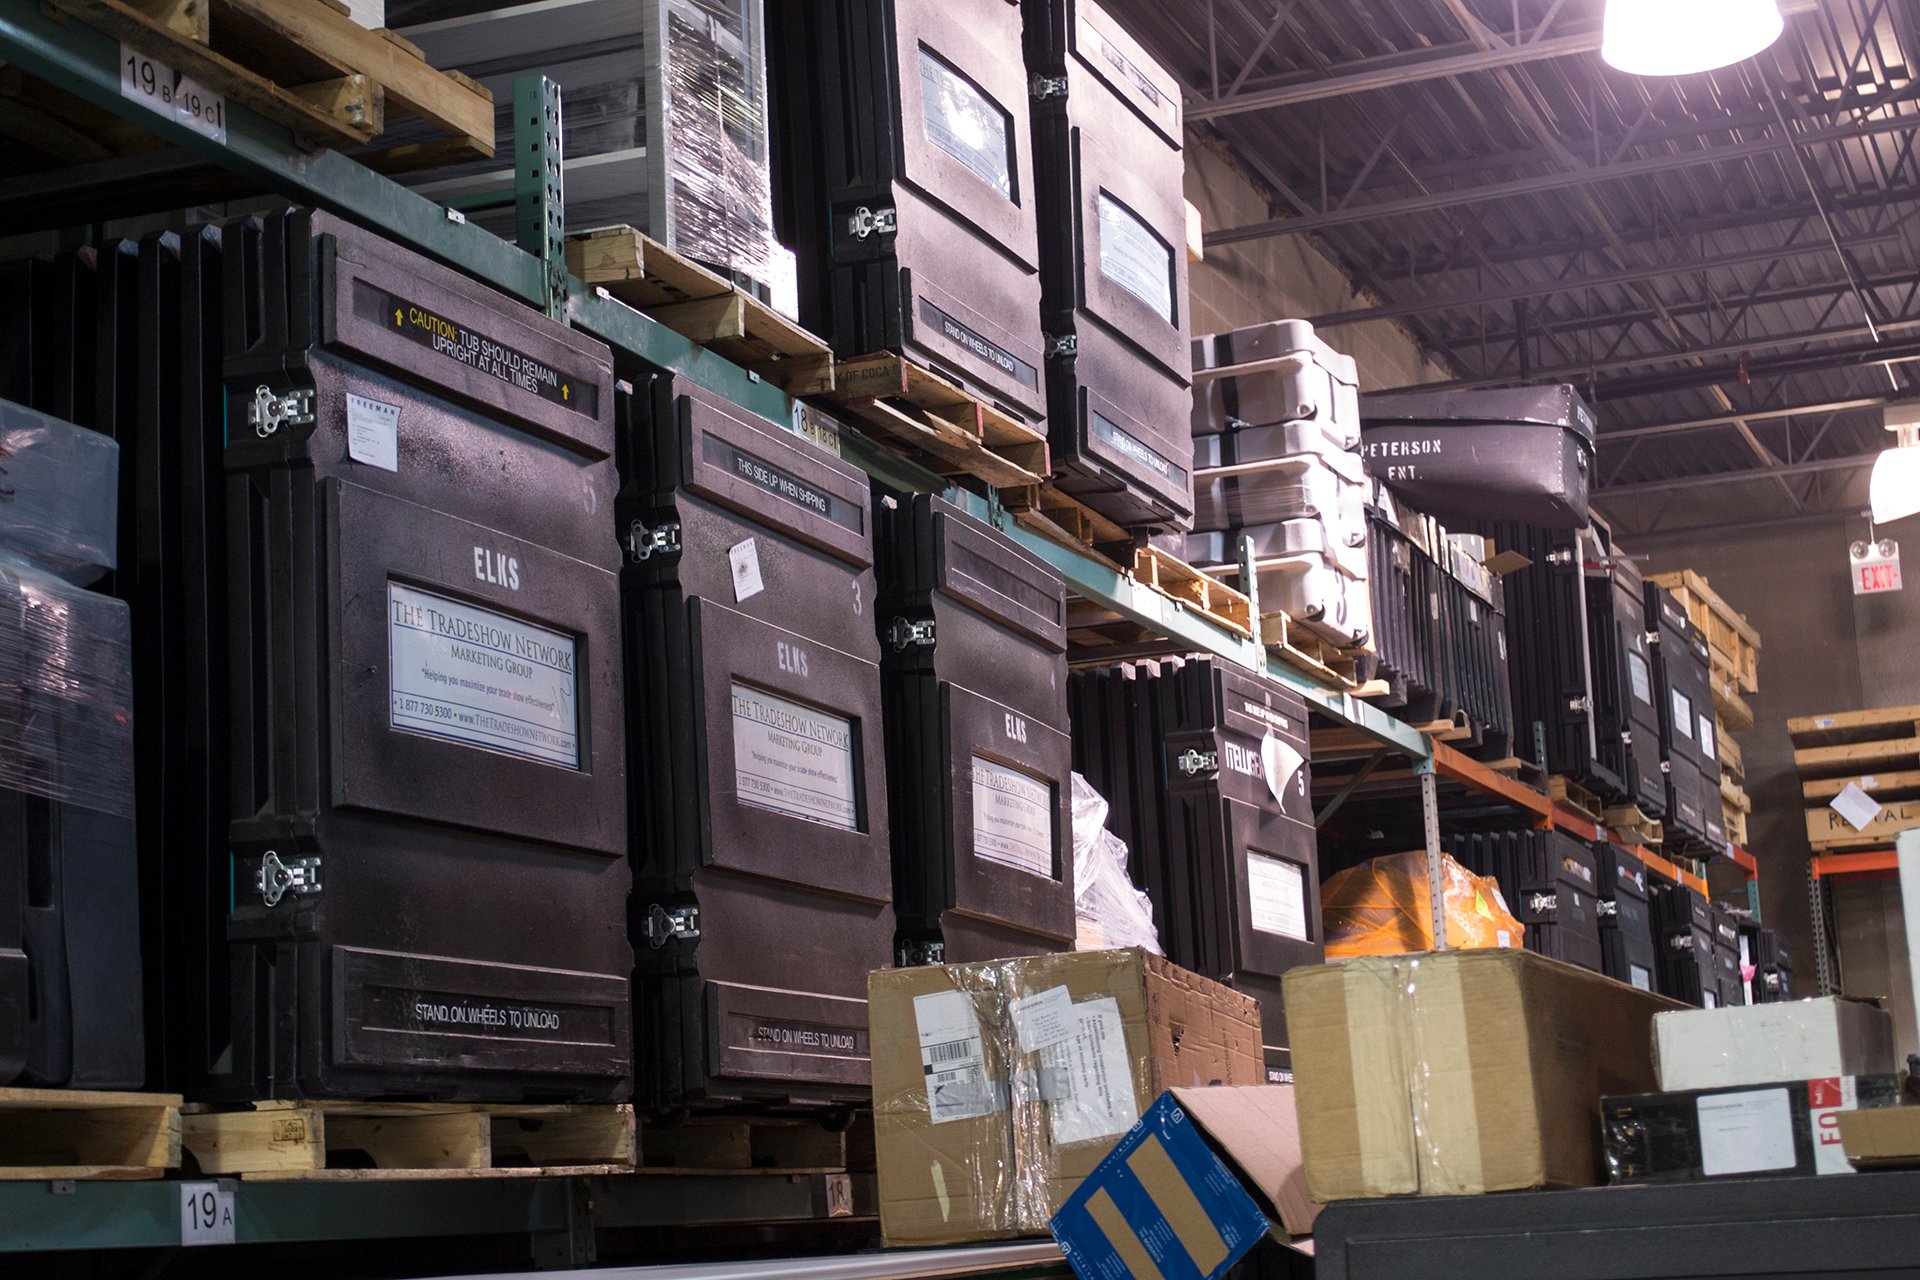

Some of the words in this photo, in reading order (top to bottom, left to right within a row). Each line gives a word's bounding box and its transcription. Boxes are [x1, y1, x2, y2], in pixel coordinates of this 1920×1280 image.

[127, 55, 156, 96] 19
[162, 84, 172, 104] B
[183, 92, 201, 118] 19
[205, 106, 215, 124] C
[409, 308, 458, 342] CAUTION:
[459, 329, 480, 352] TUB
[482, 340, 521, 369] SHOULD
[523, 359, 557, 387] REMAIN
[944, 321, 960, 339] STAND
[960, 331, 968, 344] ON
[988, 347, 995, 361] TO
[432, 333, 477, 368] UPRIGHT
[478, 355, 490, 373] AT
[492, 361, 509, 382] ALL
[510, 368, 538, 393] TIMES
[861, 366, 888, 381] COCA
[351, 397, 395, 416] FREEMAN
[794, 405, 808, 433] 18
[818, 425, 828, 444] 18
[1360, 439, 1441, 457] PETERSON
[737, 457, 753, 476] THIS
[753, 465, 768, 484] SIDE
[769, 472, 778, 487] UP
[779, 478, 798, 498] WHEN
[798, 487, 826, 511] SHIPPING
[1388, 465, 1423, 480] ENT.
[473, 546, 520, 591] ELKS
[1861, 564, 1893, 590] EXIT
[852, 579, 863, 617] 3
[393, 600, 423, 628] THE
[427, 608, 513, 649] TRADESHOW
[515, 633, 572, 671] NETWORK
[451, 645, 503, 671] MARKETING
[505, 658, 533, 680] GROUP
[777, 641, 809, 678] ELKS
[448, 676, 459, 687] you
[460, 678, 485, 693] maximize
[486, 684, 499, 696] your
[499, 687, 512, 701] trade
[513, 690, 525, 703] show
[399, 697, 404, 710] 1
[405, 700, 418, 714] 877
[420, 702, 433, 716] 730
[434, 706, 452, 720] 5300
[732, 694, 751, 717] THE
[752, 701, 807, 734] TRADESHOW
[809, 720, 850, 748] NETWORK
[767, 730, 801, 752] MARKETING
[801, 740, 823, 757] GROUP
[1005, 713, 1027, 744] ELKS
[1297, 770, 1305, 797] 5
[416, 1003, 448, 1022] STAND
[450, 1006, 466, 1023] ON
[468, 1008, 506, 1026] WHEELS
[509, 1010, 522, 1028] TO
[523, 1013, 559, 1030] UNLOAD
[782, 1029, 793, 1043] ON
[794, 1030, 819, 1046] WHEELS
[820, 1033, 829, 1047] TO
[830, 1035, 854, 1049] UNLOAD
[187, 1192, 217, 1231] 19
[222, 1207, 233, 1226] A
